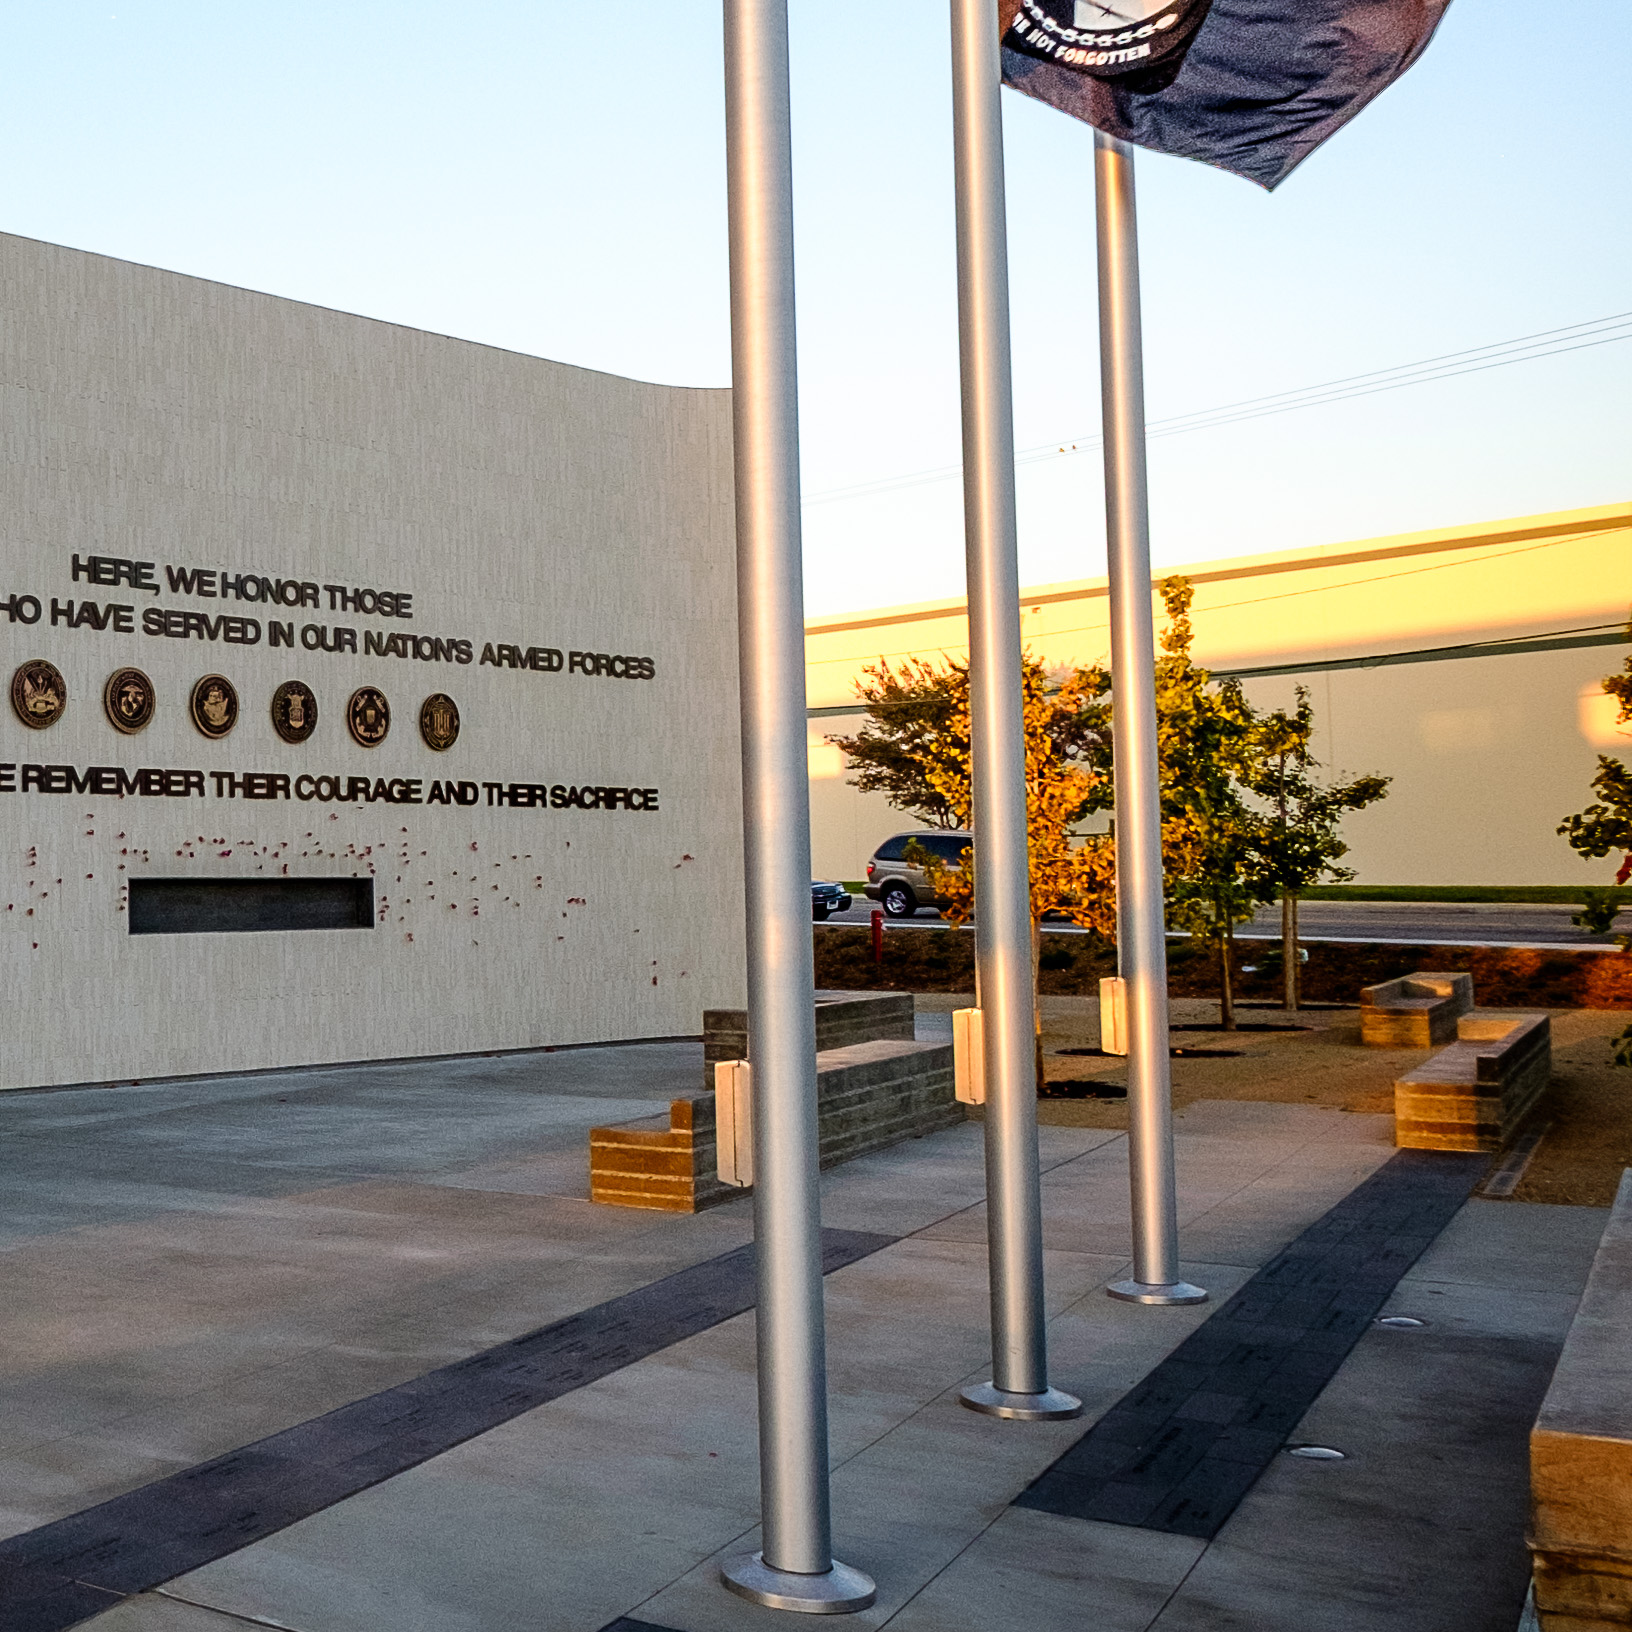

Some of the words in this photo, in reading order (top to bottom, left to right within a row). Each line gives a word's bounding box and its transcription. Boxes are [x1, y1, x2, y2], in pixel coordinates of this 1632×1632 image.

[1054, 43, 1152, 66] FORGOTTEN
[72, 553, 160, 597] HERE,
[165, 564, 217, 598] WE
[221, 571, 321, 609] HONOR
[324, 583, 413, 618] THOSE
[50, 597, 135, 633] HAVE
[142, 607, 262, 645] SERVED
[268, 620, 295, 648] IN
[300, 623, 358, 654] OUR
[364, 629, 473, 664] NATION'S
[479, 642, 564, 672] ARMED
[568, 650, 657, 680] FORCES
[21, 763, 206, 798] REMEMBER
[209, 770, 292, 800] THEIR
[294, 773, 423, 804] COURAGE
[426, 780, 480, 806] AND
[482, 781, 548, 808] THEIR
[550, 784, 660, 811] SACRIFICE
